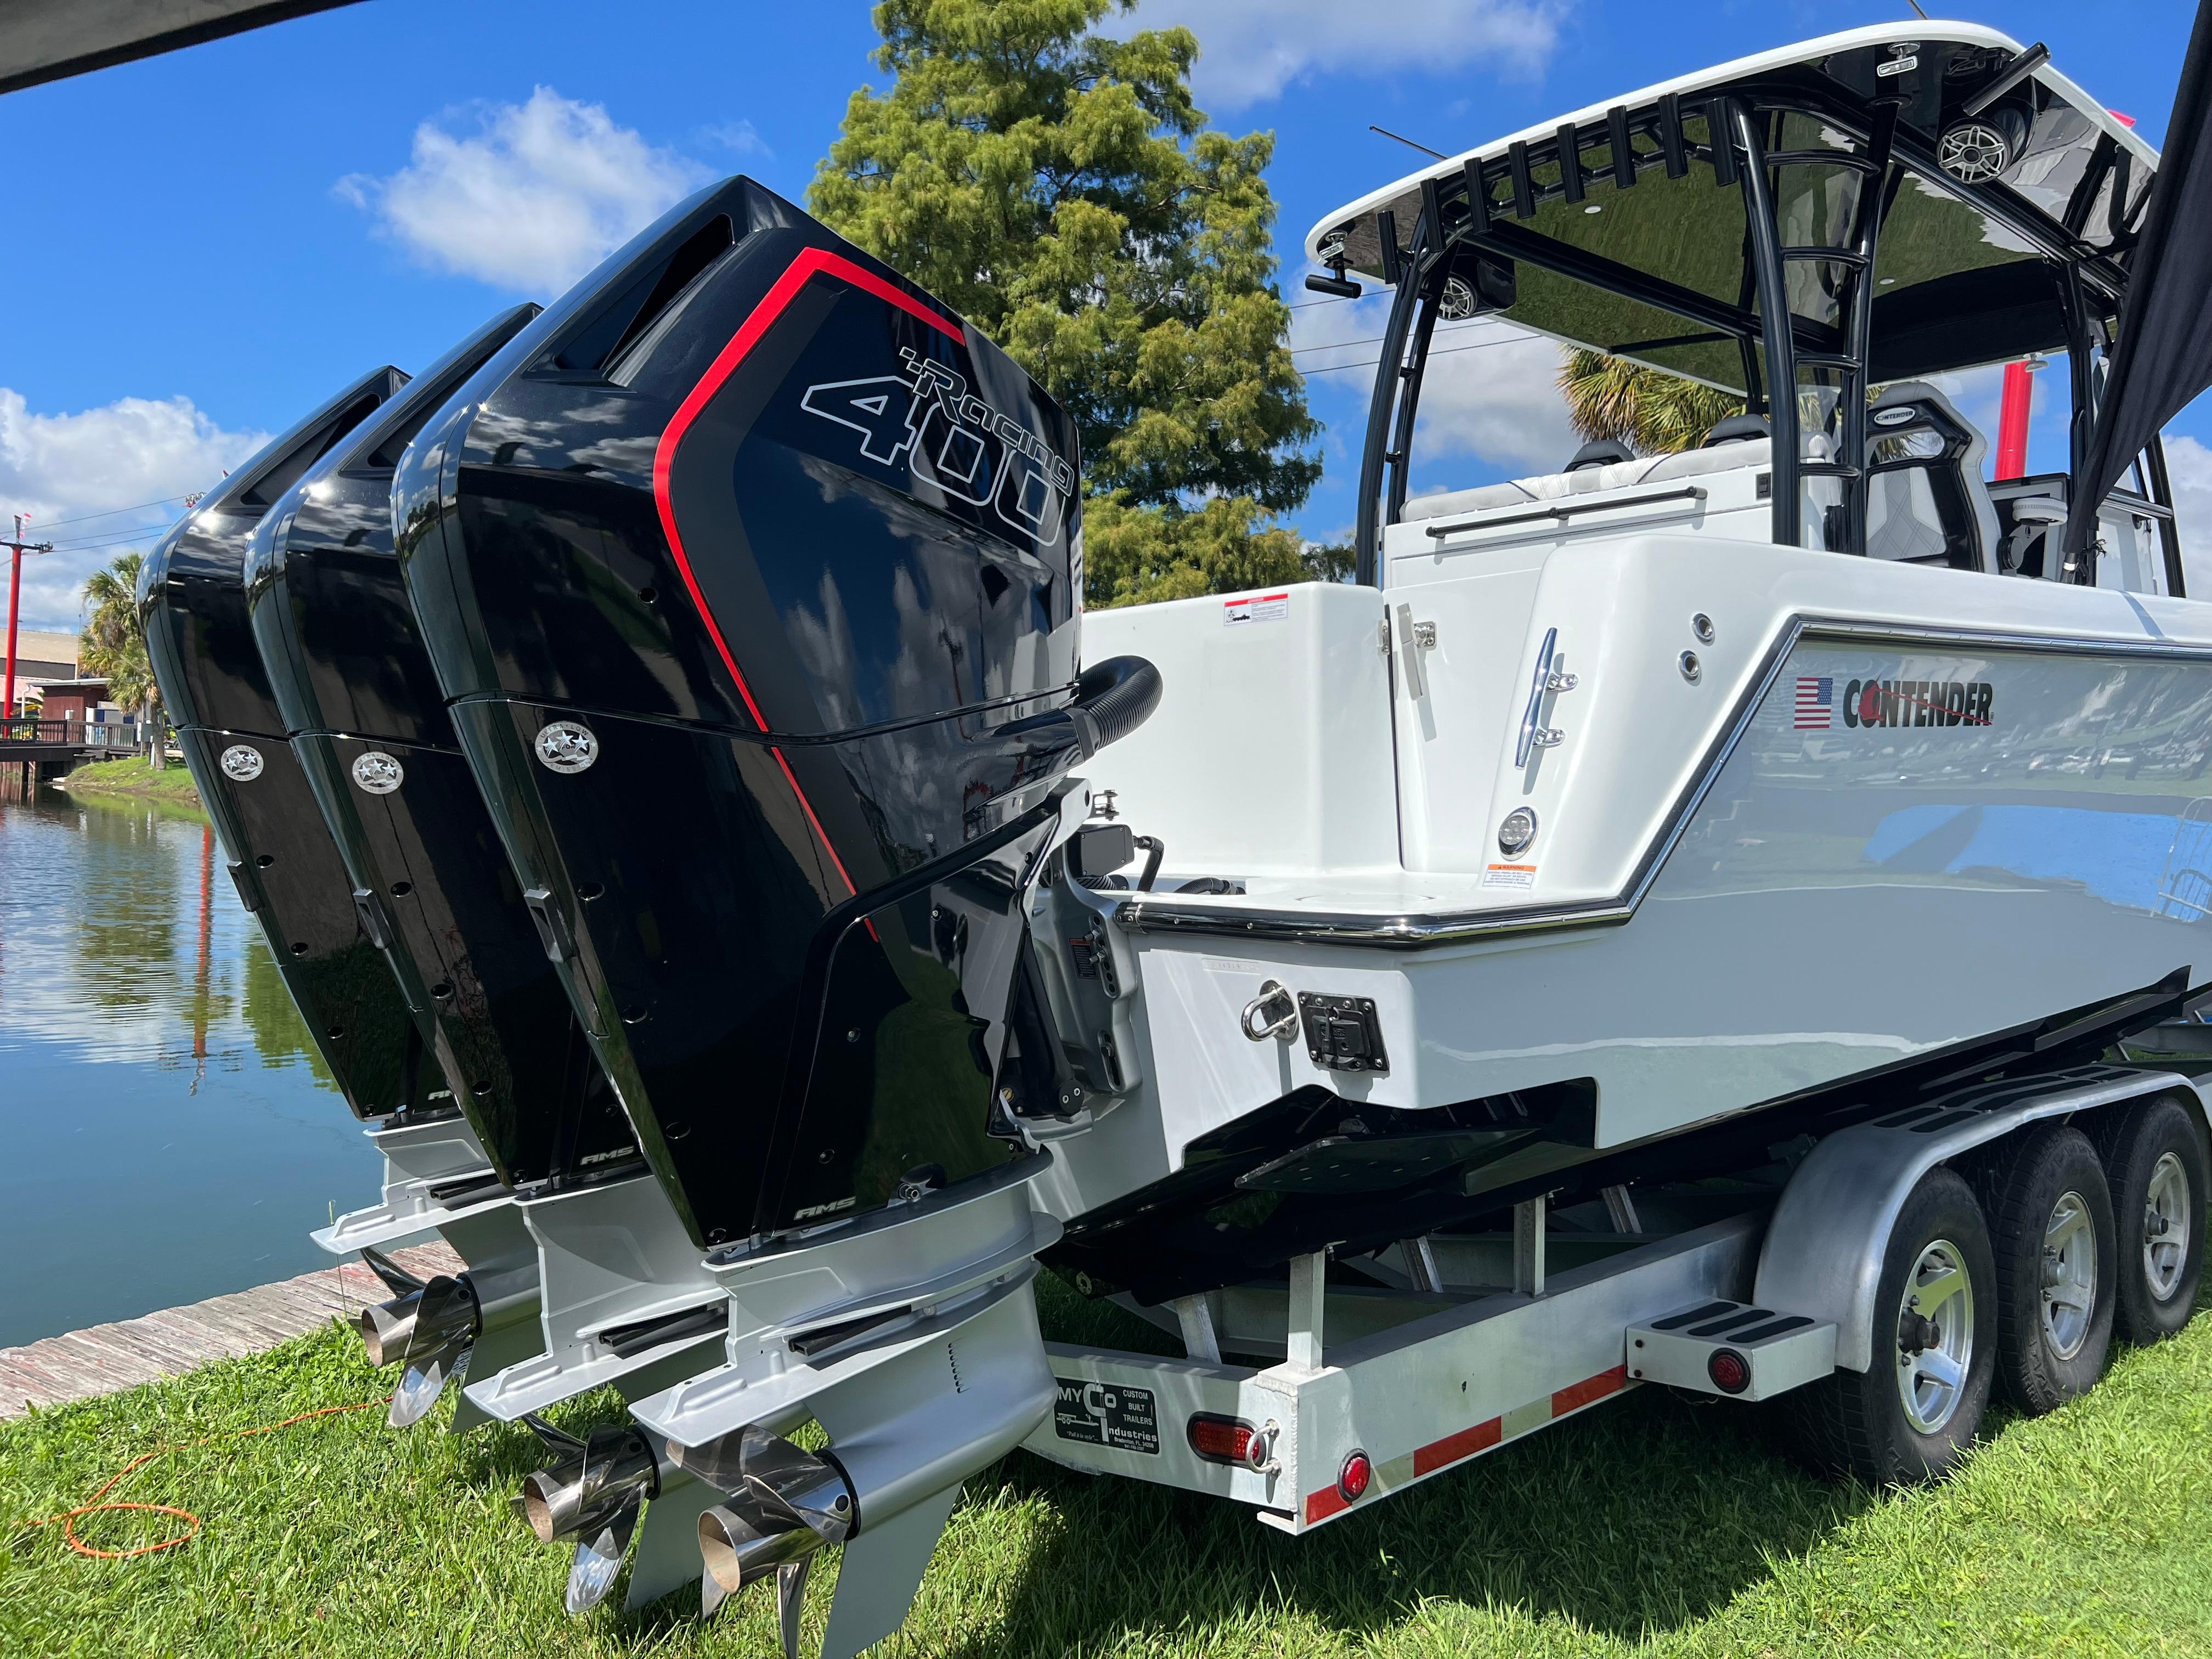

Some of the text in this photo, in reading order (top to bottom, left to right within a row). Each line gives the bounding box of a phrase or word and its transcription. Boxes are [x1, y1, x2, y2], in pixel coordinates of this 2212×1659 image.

[899, 346, 1074, 496] Racing
[1876, 411, 1914, 421] CONTENDER
[800, 375, 1066, 547] 400
[1843, 679, 1993, 728] CONTENDER
[571, 724, 589, 736] LOW
[381, 754, 396, 764] LOW
[580, 1146, 634, 1165] AMS
[794, 1196, 856, 1221] AMS
[1122, 1389, 1148, 1400] CUSTOM
[1128, 1402, 1145, 1412] BUILT
[1122, 1414, 1153, 1426] TRAILERS
